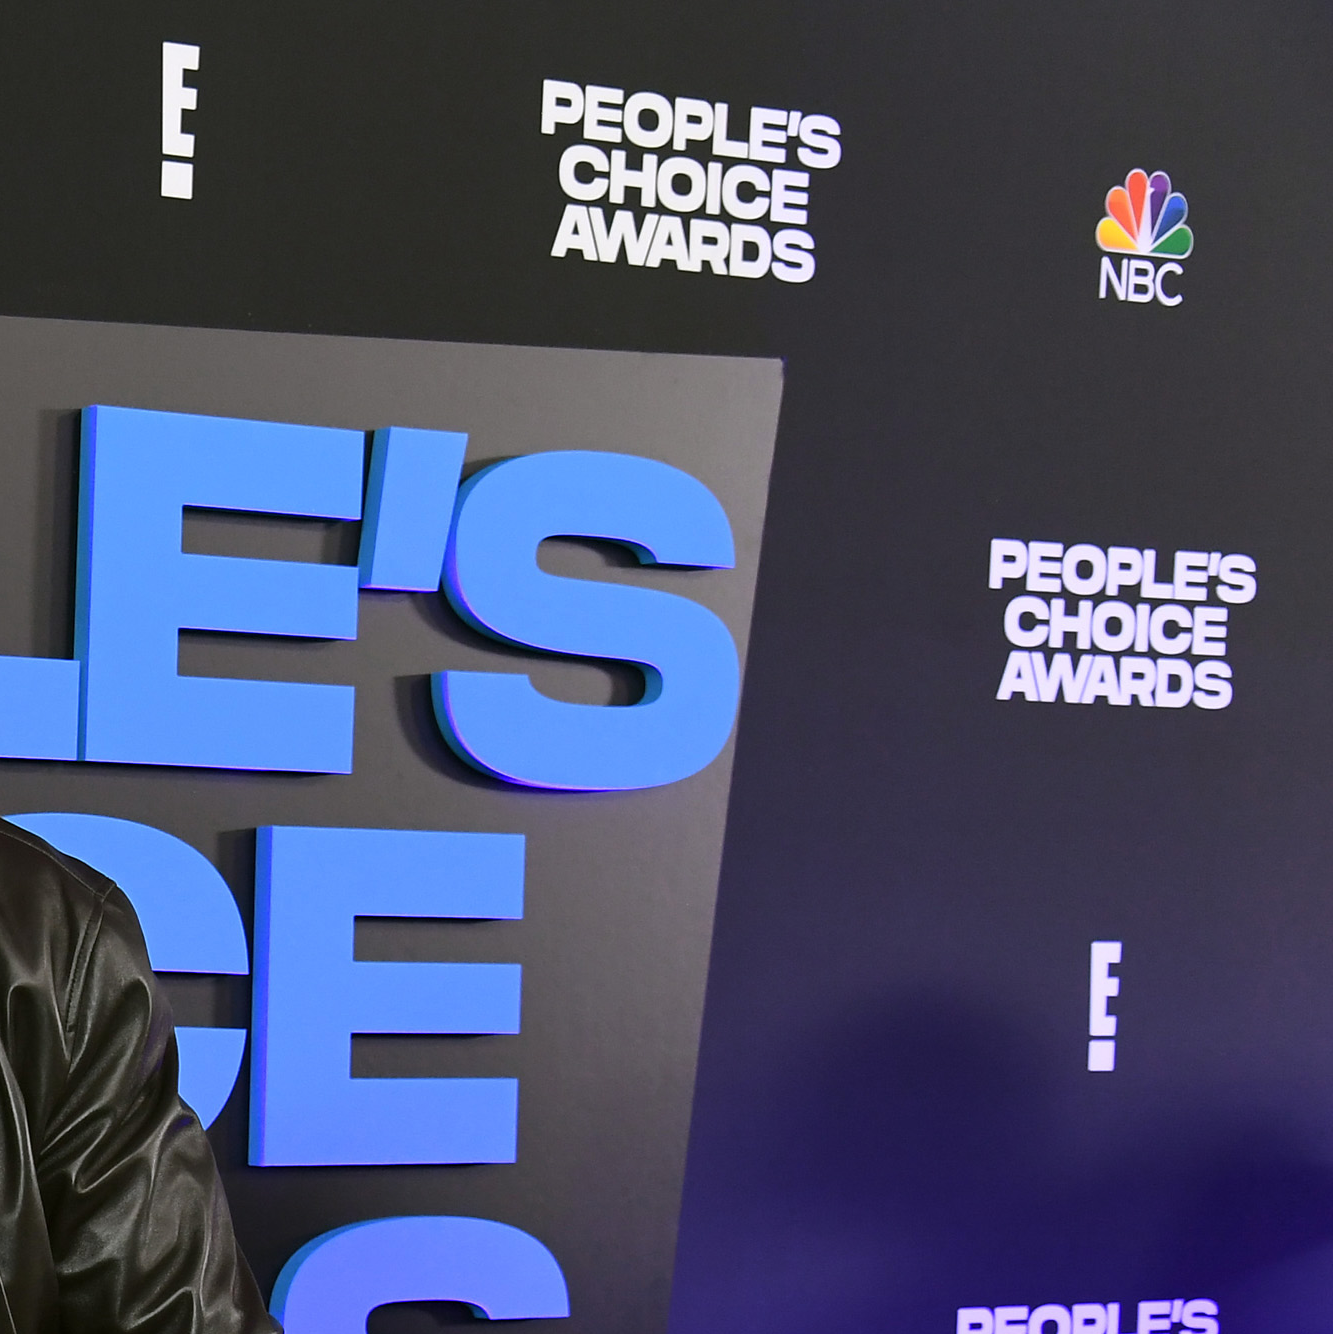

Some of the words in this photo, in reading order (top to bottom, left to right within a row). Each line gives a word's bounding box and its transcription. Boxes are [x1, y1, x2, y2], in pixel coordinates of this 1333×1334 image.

[540, 79, 842, 169] PEOPLE'S
[558, 144, 810, 225] CHOICE
[550, 203, 816, 283] AWARDS
[1098, 255, 1184, 307] NBC
[988, 538, 1257, 604] PEOPLE'S
[1004, 595, 1228, 657] CHOICE
[996, 650, 1233, 710] AWARDS
